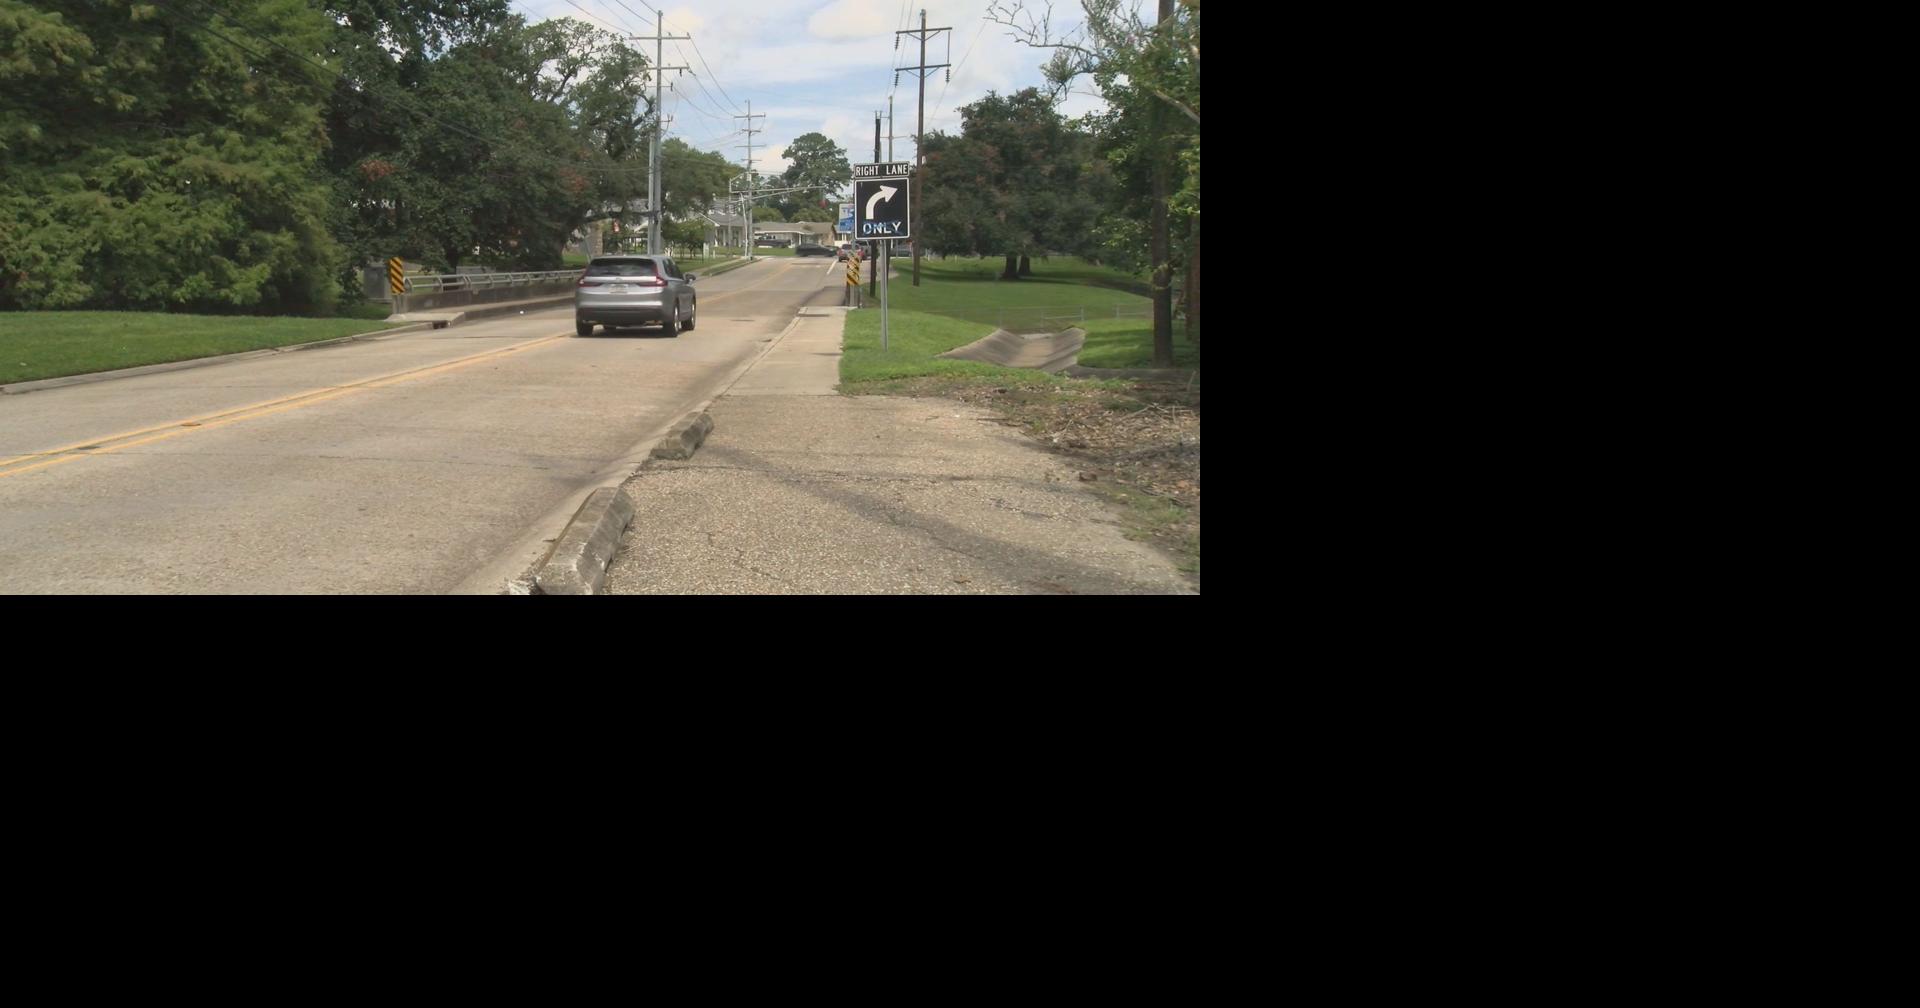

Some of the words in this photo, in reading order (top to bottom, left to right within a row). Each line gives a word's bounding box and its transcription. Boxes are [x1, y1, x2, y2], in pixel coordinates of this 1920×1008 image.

[855, 165, 879, 176] RIGHT
[886, 164, 908, 175] LANE
[863, 221, 901, 235] ONLY
